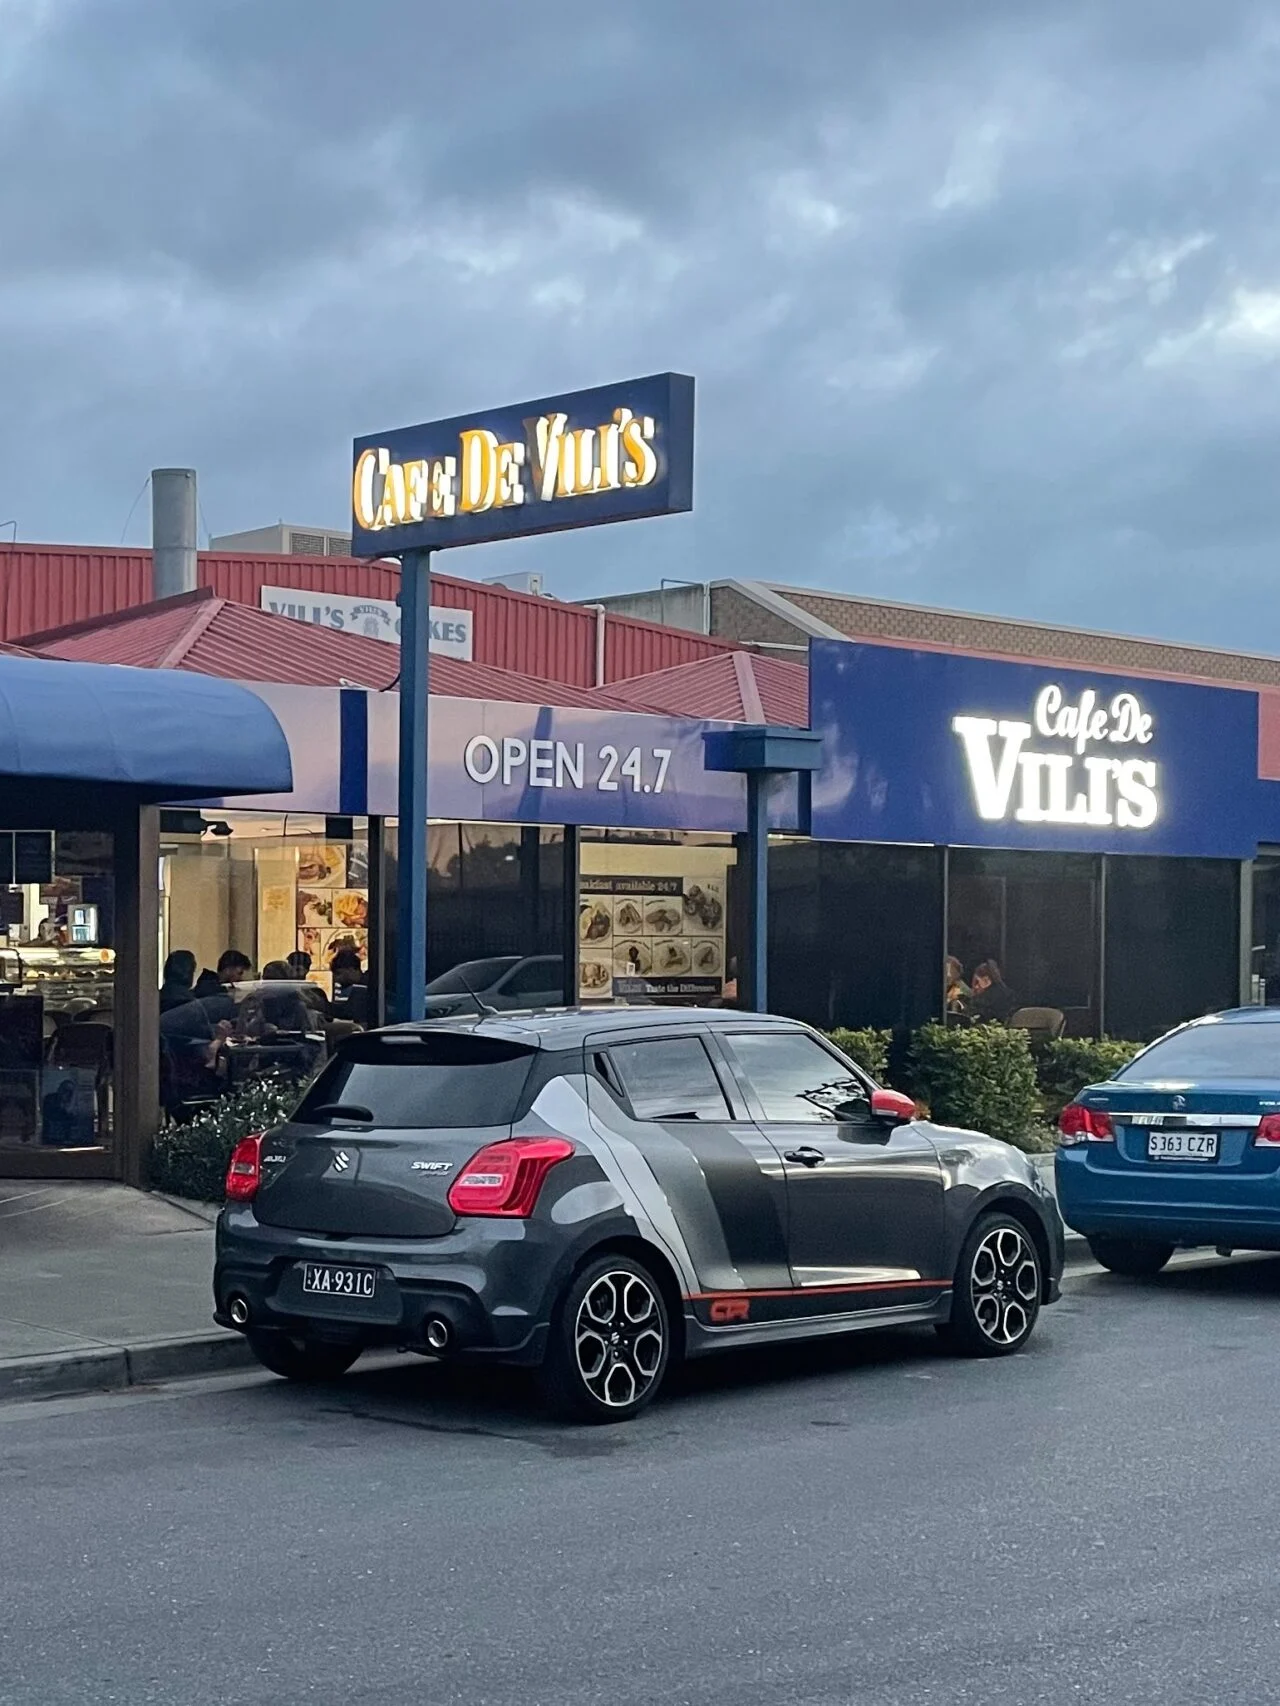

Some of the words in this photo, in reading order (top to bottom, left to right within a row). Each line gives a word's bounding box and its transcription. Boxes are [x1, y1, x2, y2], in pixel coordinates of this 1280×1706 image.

[354, 447, 457, 531] CAFE
[459, 429, 525, 513] DE
[523, 407, 657, 501] VILI'S
[1035, 684, 1109, 755] Cafe
[1109, 693, 1154, 744] De
[464, 734, 585, 789] OPEN
[597, 744, 672, 794] 24.7
[952, 715, 1158, 829] VILI'S
[410, 1161, 454, 1171] SWIFT
[1150, 1136, 1182, 1152] S363
[1187, 1137, 1216, 1153] CZR
